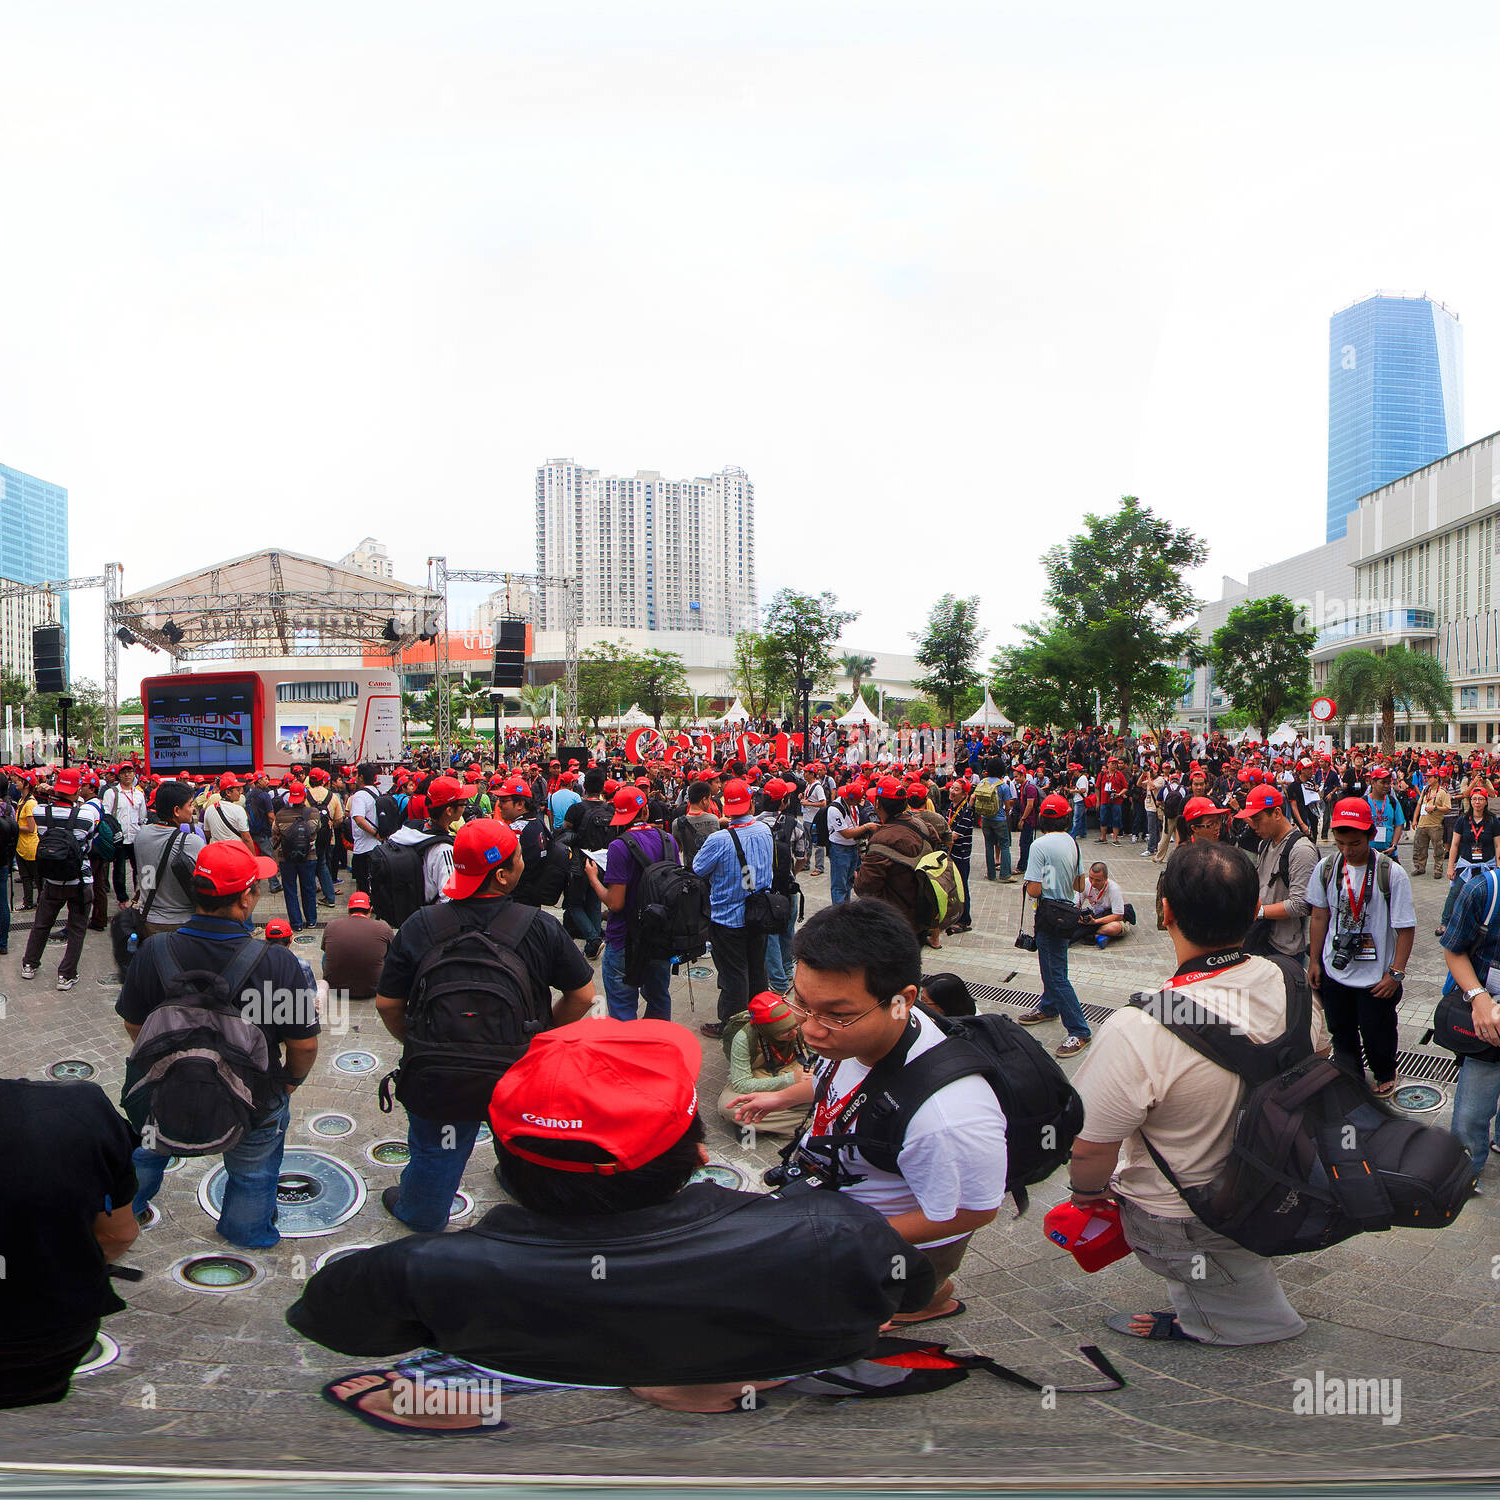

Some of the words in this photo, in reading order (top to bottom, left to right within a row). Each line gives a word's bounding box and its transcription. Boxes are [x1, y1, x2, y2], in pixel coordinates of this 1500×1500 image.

[835, 817, 843, 827] 3
[1340, 810, 1360, 818] Canon
[1205, 951, 1240, 967] Canon
[824, 1102, 844, 1120] Canon
[842, 1092, 868, 1123] Canon
[521, 1113, 583, 1129] Canon
